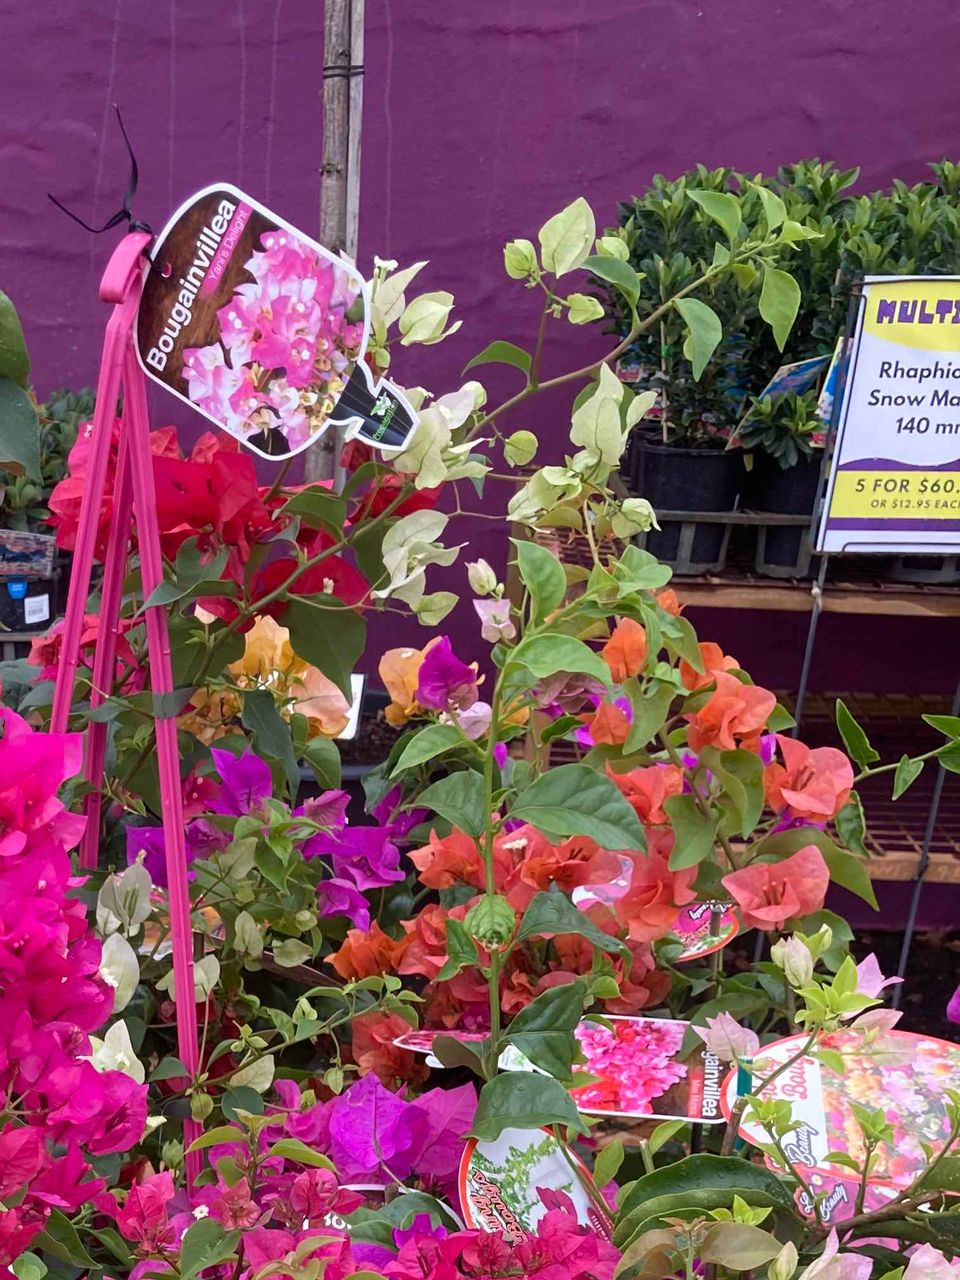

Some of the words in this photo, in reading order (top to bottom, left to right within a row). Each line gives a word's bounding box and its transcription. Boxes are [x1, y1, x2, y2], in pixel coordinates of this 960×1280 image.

[208, 247, 231, 282] Yani's
[223, 210, 248, 250] Delight
[146, 199, 237, 372] Bougainvillea
[868, 390, 926, 406] Snow
[896, 417, 930, 434] 140
[855, 479, 866, 492] 5
[873, 479, 910, 493] FOR
[871, 499, 887, 508] OR
[892, 499, 930, 509] $12.95
[701, 1049, 722, 1118] gainvillea
